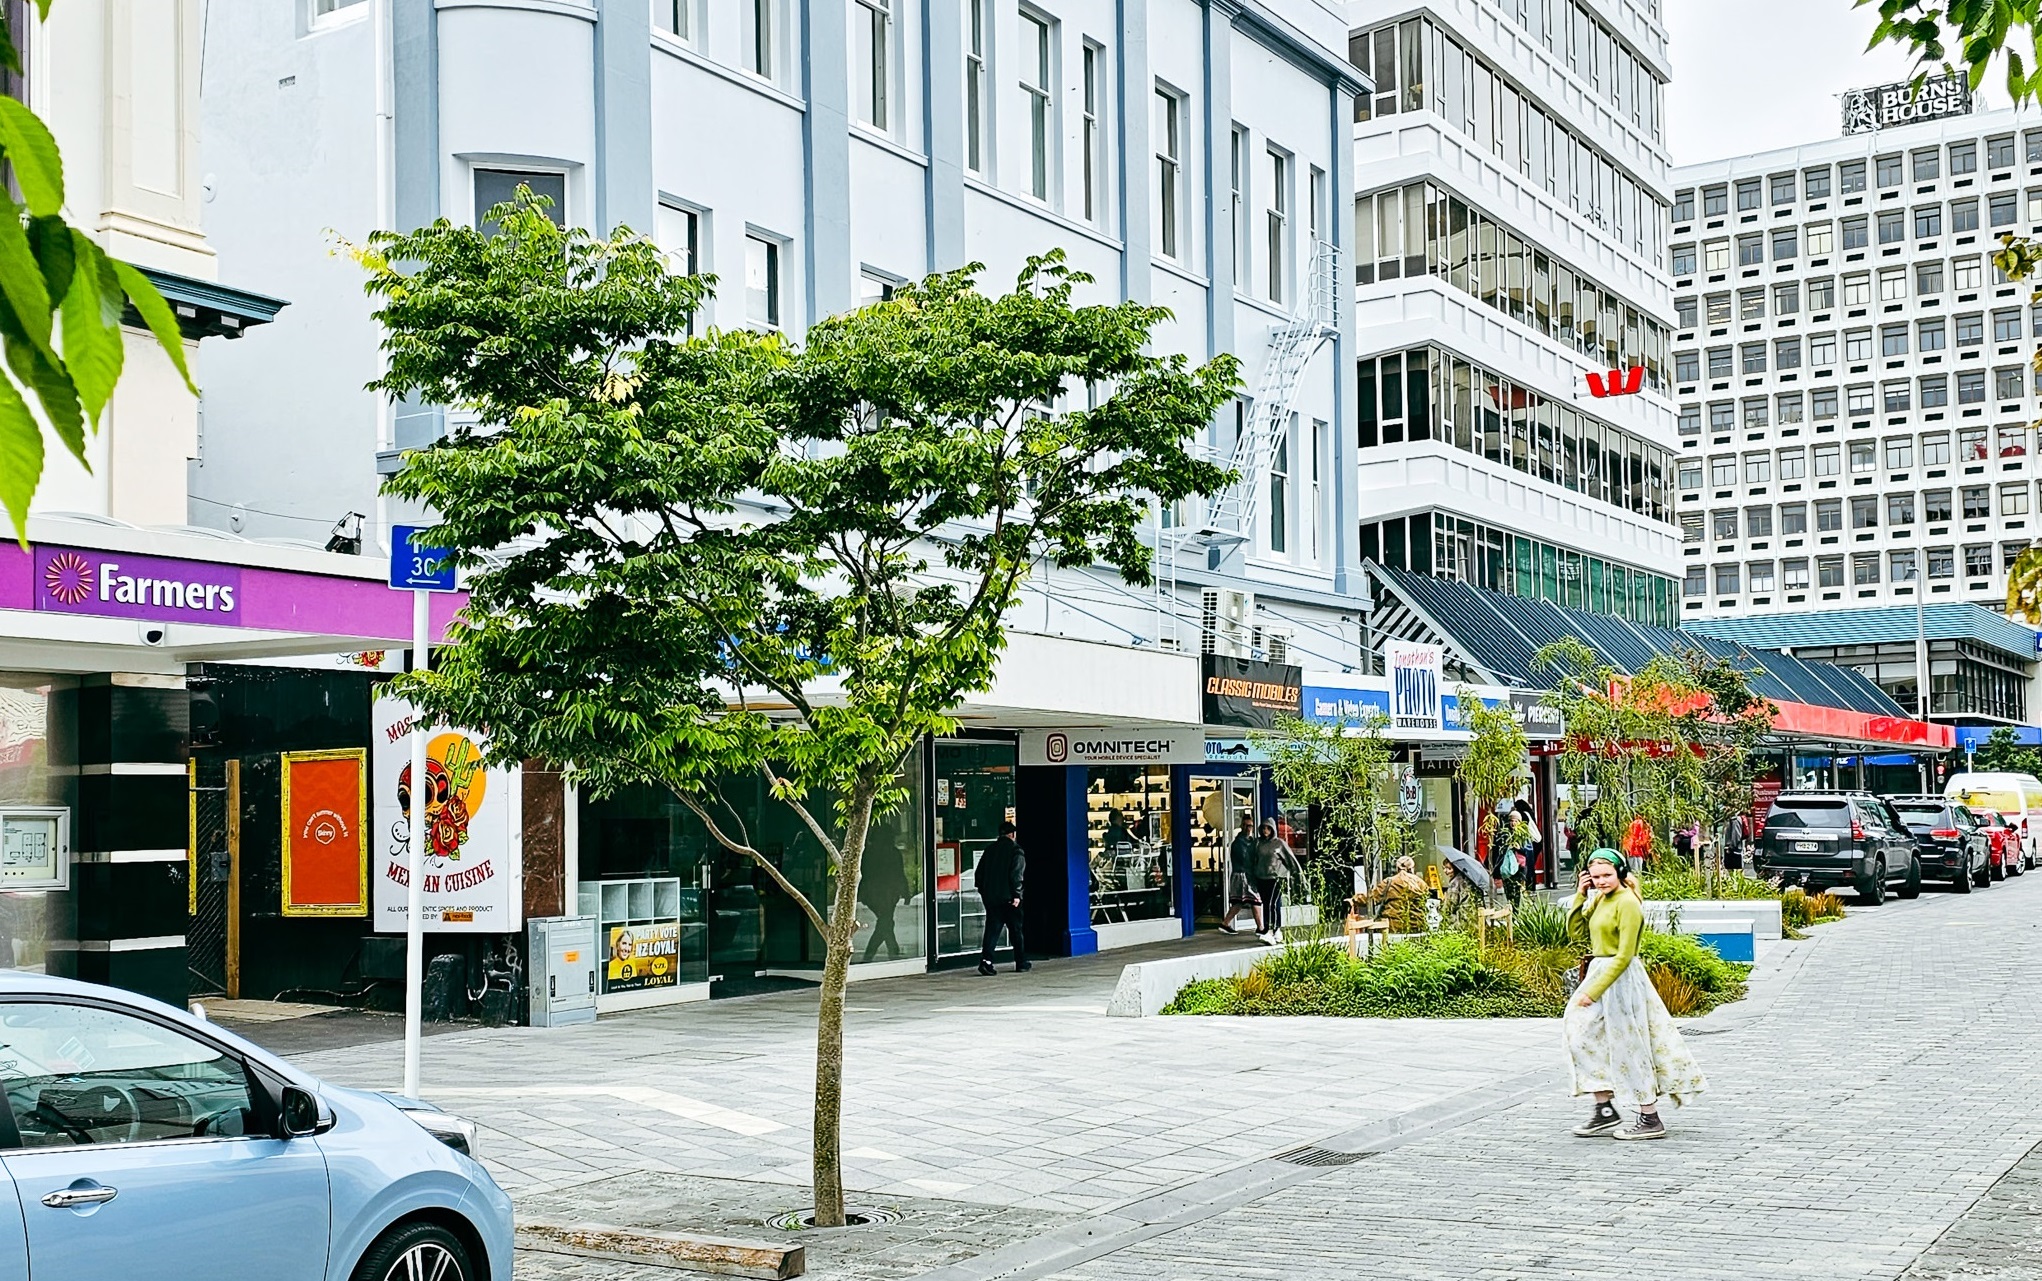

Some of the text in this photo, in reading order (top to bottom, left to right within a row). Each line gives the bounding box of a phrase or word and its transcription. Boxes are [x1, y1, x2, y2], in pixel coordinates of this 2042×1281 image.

[1882, 79, 1962, 108] BURNS
[1882, 95, 1963, 124] HOUSE
[99, 563, 235, 612] Farmers
[1206, 677, 1299, 703] CLASSIC MOBILES
[1394, 667, 1436, 717] PHOTO
[1315, 697, 1337, 717] Camera
[1343, 699, 1359, 718] Video
[1397, 718, 1437, 729] WAREHOUSE
[1073, 740, 1170, 754] OMNITECH
[1204, 741, 1222, 755] OTO
[386, 859, 494, 893] MEXAN CUISINE
[637, 926, 678, 939] PARTY VOTE
[648, 940, 677, 955] LOYAL
[644, 976, 673, 986] LOYAL
